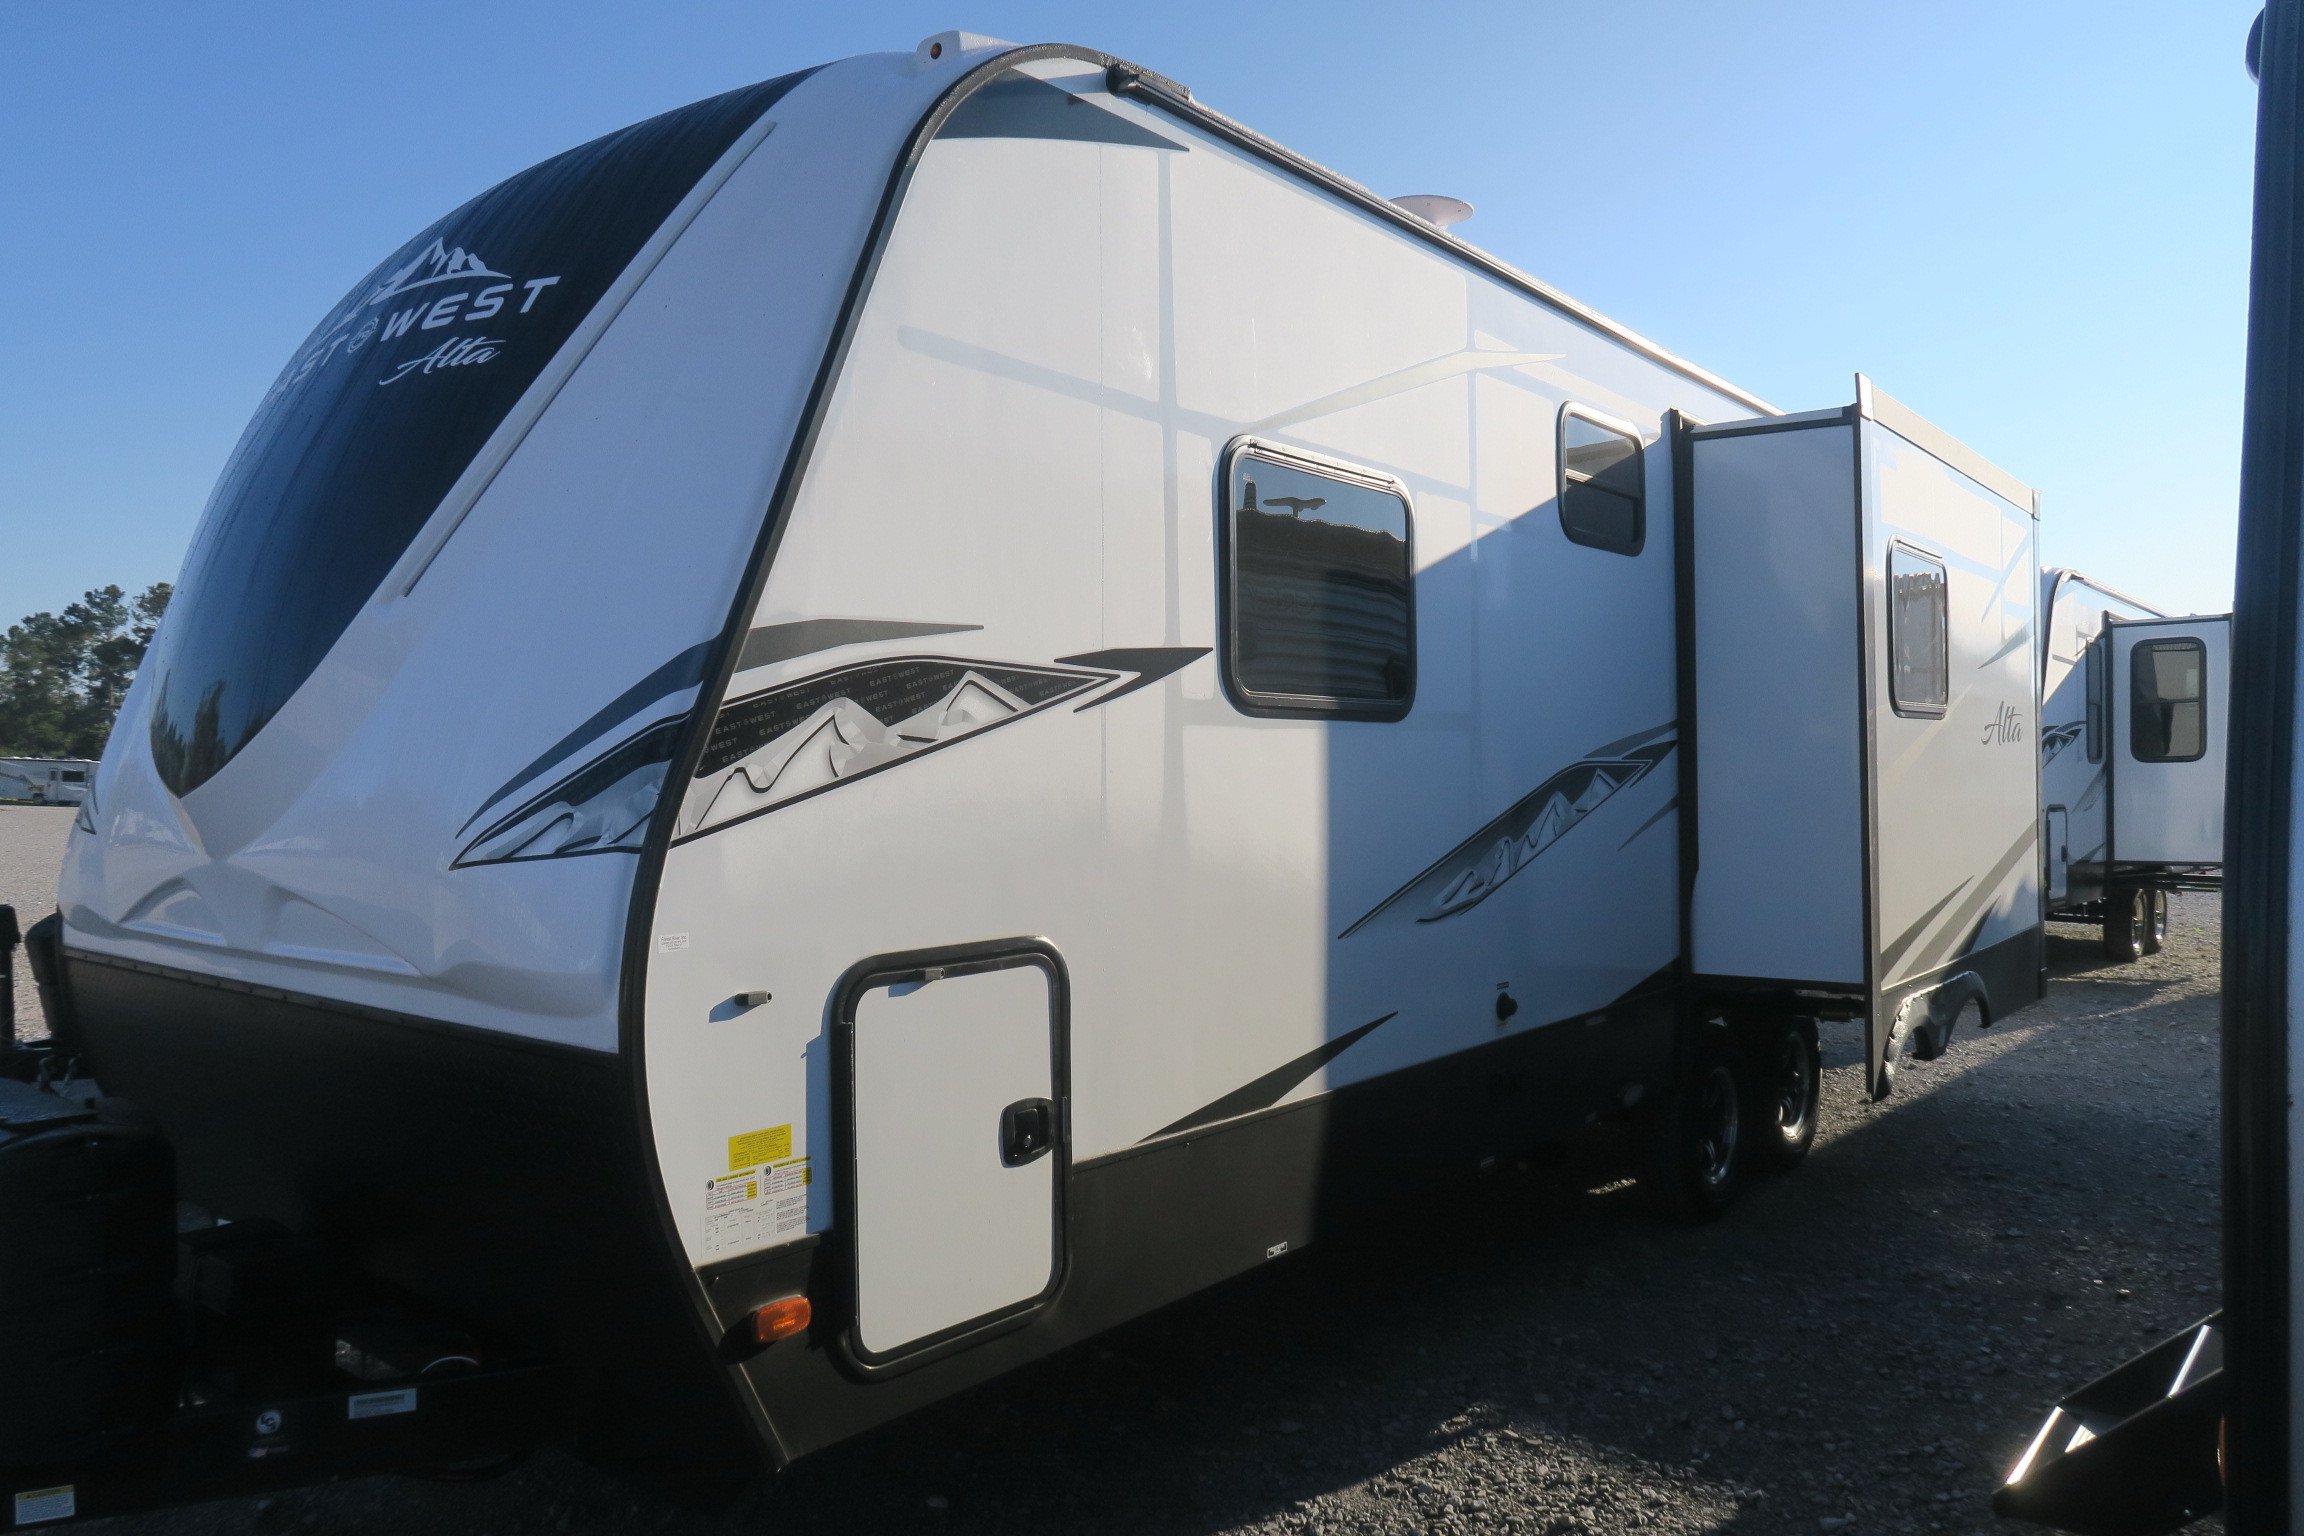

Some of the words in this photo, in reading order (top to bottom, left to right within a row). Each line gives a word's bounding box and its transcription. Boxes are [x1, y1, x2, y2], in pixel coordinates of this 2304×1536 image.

[381, 276, 562, 343] WEST
[379, 336, 507, 386] Alta
[1980, 700, 2024, 746] Alta
